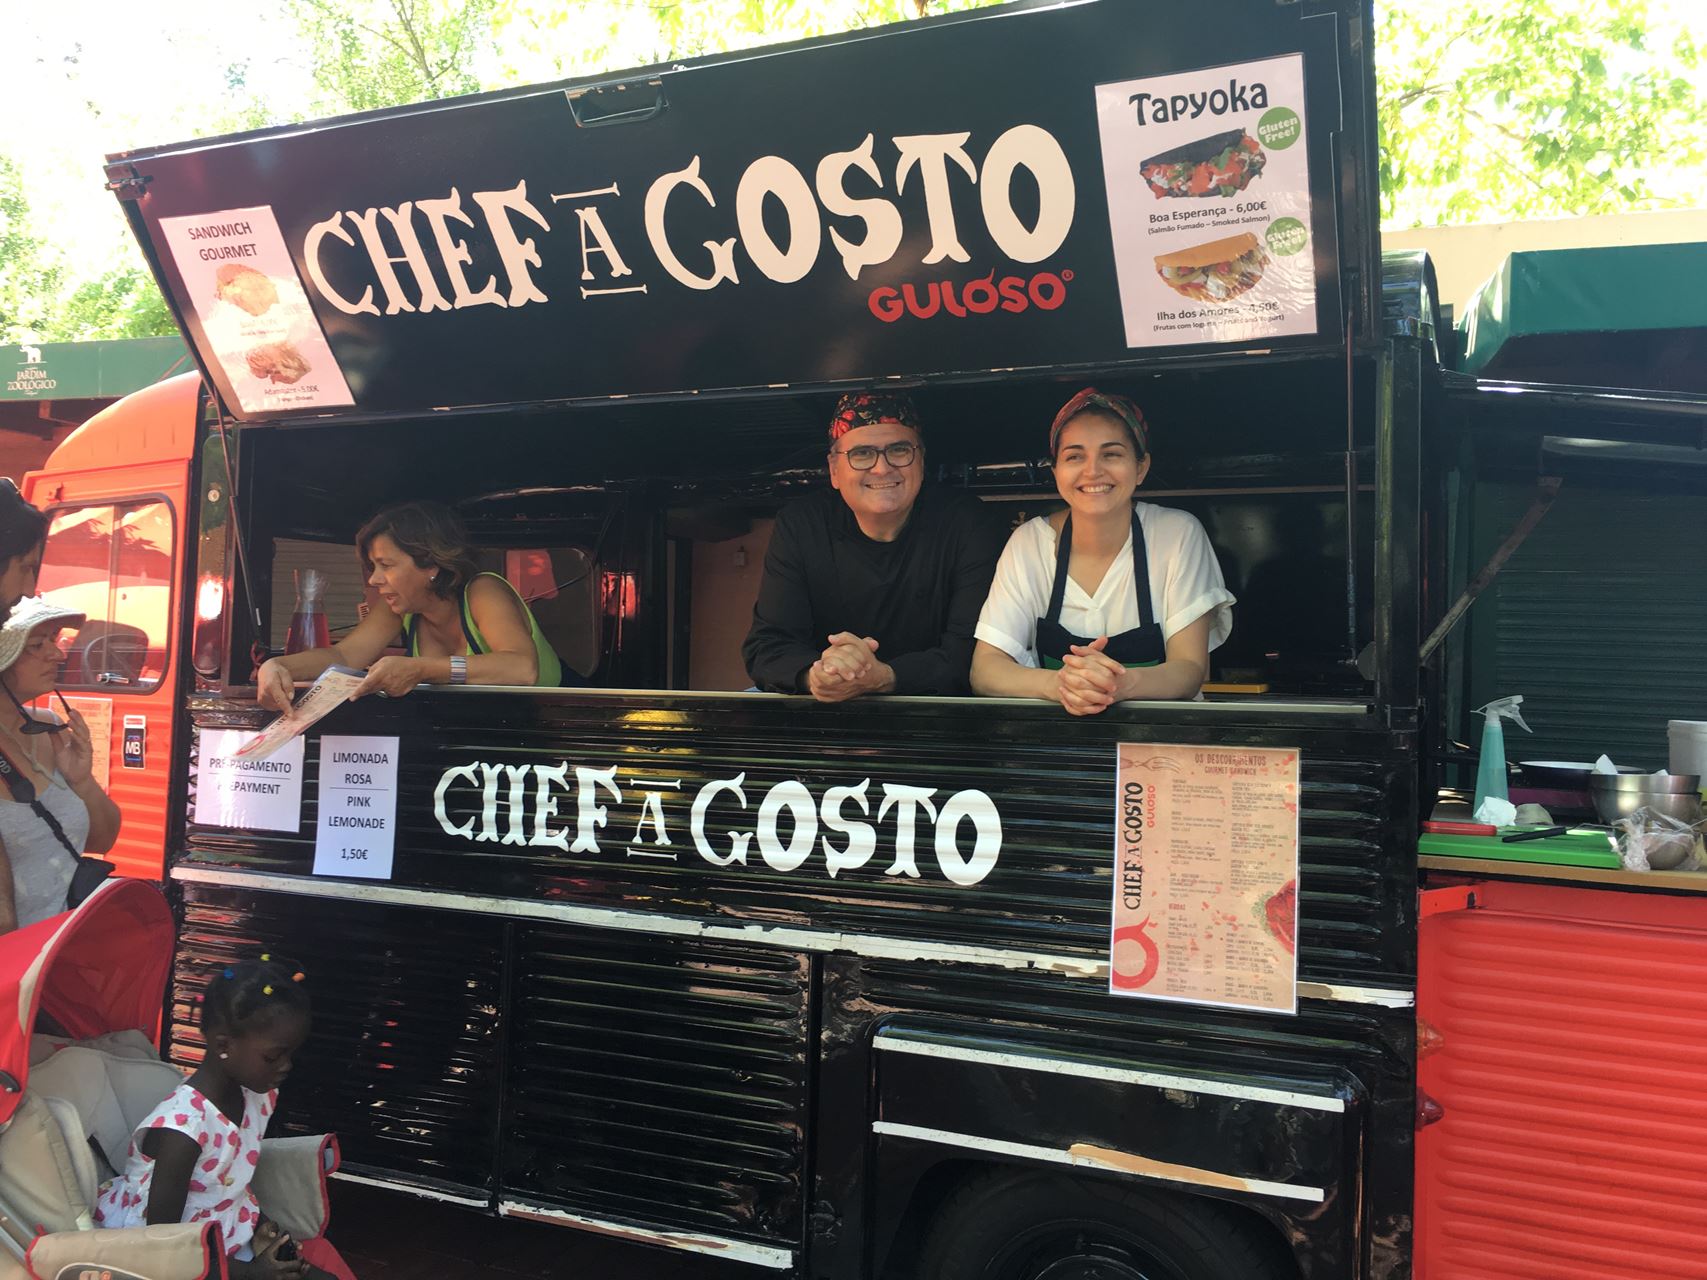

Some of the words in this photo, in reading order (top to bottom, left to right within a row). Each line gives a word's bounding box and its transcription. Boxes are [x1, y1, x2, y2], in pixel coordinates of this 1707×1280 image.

[1128, 79, 1268, 126] Tapyoka
[1259, 117, 1298, 135] Gluten
[1265, 126, 1295, 143] Free!
[304, 179, 551, 316] CHEF
[645, 124, 1076, 291] GOSTO
[1149, 214, 1170, 224] Boa
[1172, 207, 1226, 220] Esperança
[1236, 200, 1267, 214] 6,00€
[188, 222, 253, 240] SANDWICH
[1148, 226, 1176, 235] (Salmão
[1177, 222, 1205, 230] Fumado
[1212, 218, 1240, 226] Smoked
[1241, 214, 1270, 223] Salmon)
[200, 244, 258, 261] GOURMET
[1157, 312, 1176, 320] Ilha
[1178, 310, 1196, 319] dos
[1199, 307, 1240, 317] Amores
[1153, 324, 1176, 332] (Frutas
[126, 741, 141, 755] MB
[333, 752, 389, 765] LIMONADA
[345, 773, 372, 785] ROSA
[347, 796, 371, 807] PINK
[1147, 785, 1156, 828] GULOSO
[1123, 782, 1143, 843] GOSTO
[329, 816, 385, 829] LEMONADE
[434, 760, 622, 854] CHEF
[691, 771, 1003, 885] GOSTO
[341, 848, 368, 860] 1,50€
[1123, 860, 1142, 910] CHEF
